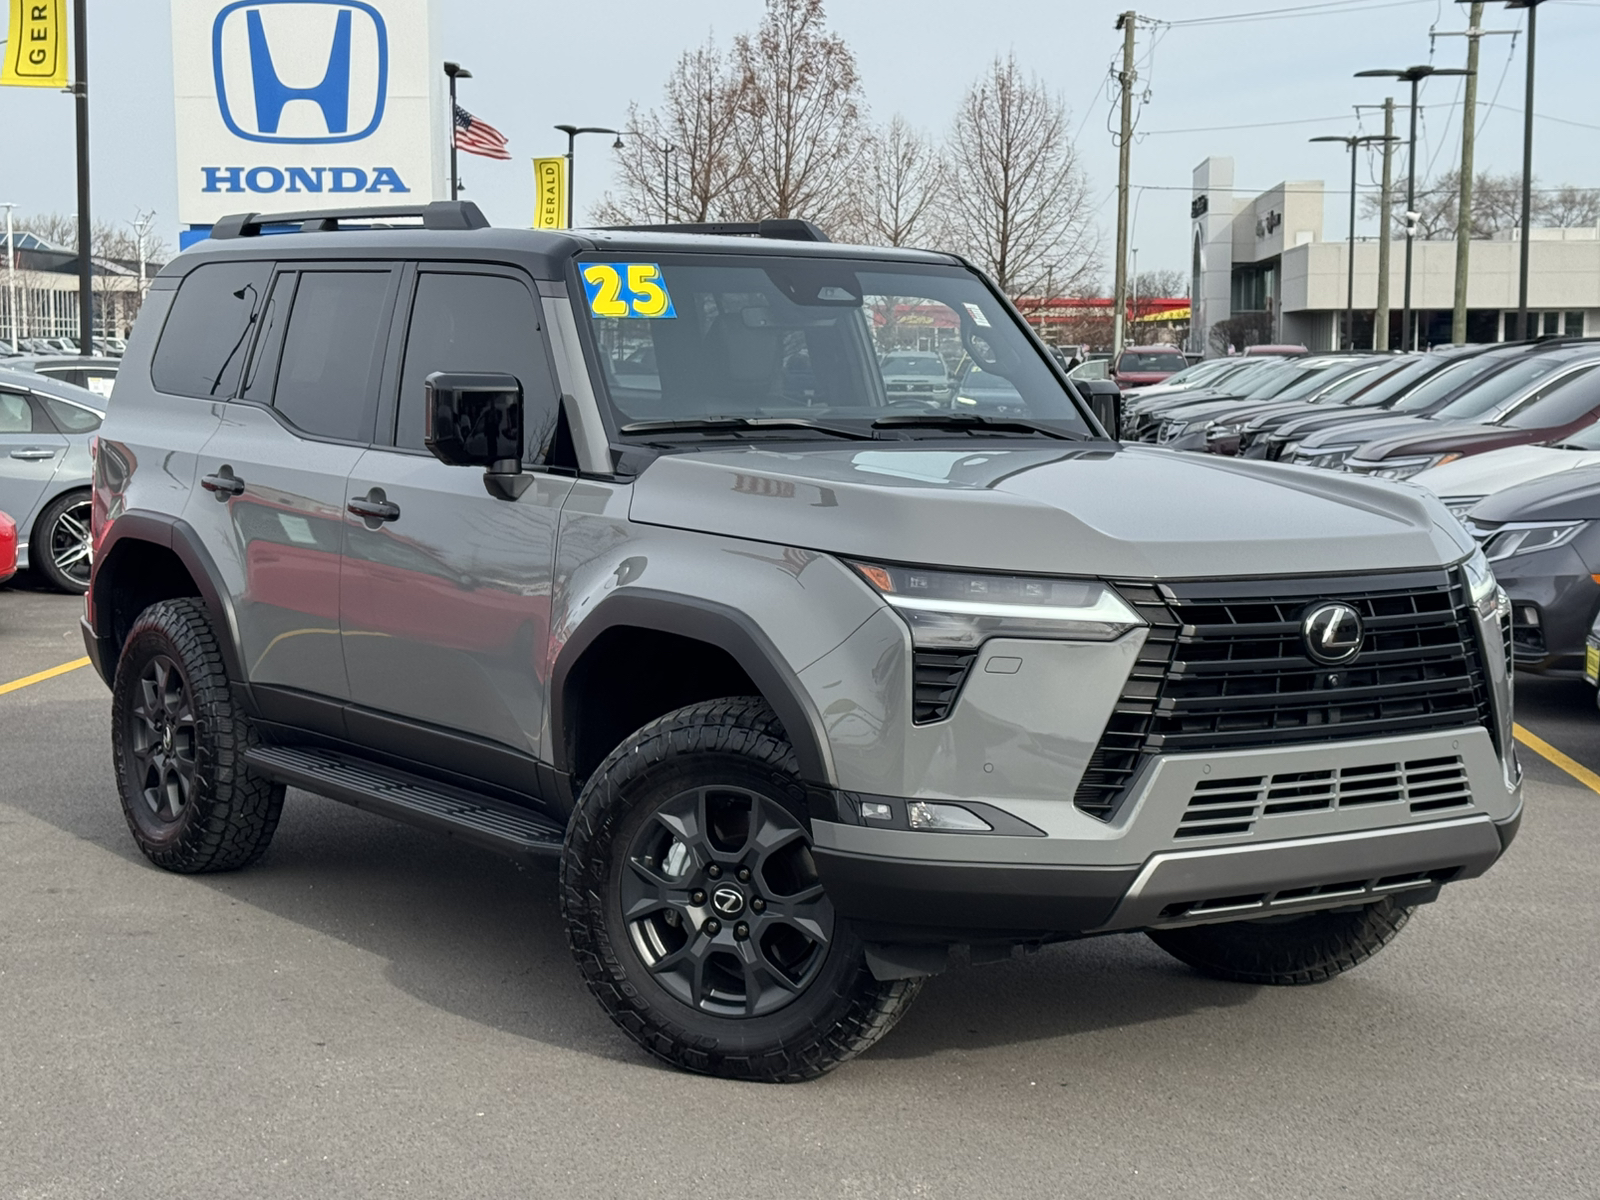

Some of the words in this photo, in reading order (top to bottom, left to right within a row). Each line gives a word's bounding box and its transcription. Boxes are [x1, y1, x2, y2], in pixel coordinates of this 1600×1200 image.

[201, 166, 411, 193] HONDA
[545, 167, 556, 225] GERALD
[584, 265, 669, 317] 25
